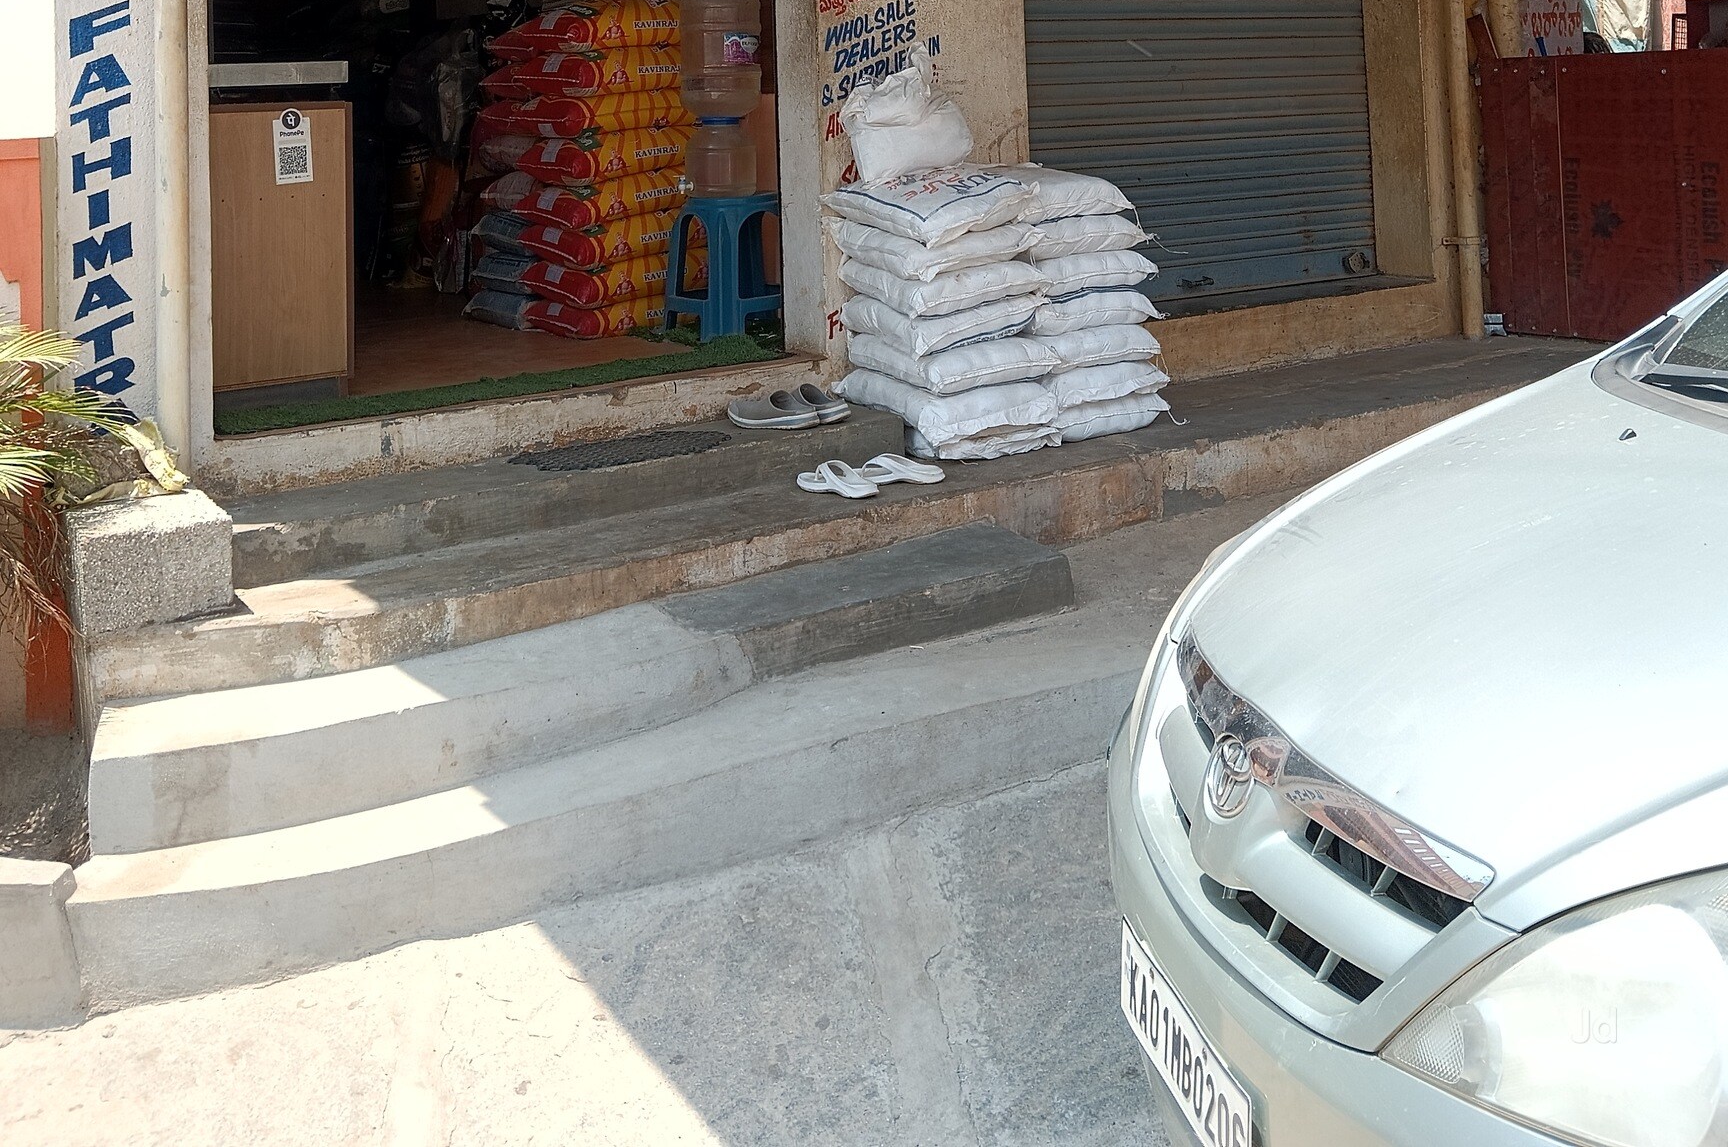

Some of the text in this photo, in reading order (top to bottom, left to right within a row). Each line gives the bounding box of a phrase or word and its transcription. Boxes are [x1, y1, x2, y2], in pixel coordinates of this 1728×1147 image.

[634, 21, 678, 29] KAVINRAJ
[834, 20, 916, 73] DEALERS
[639, 65, 680, 73] KAVINRAJ
[822, 84, 834, 107] &
[929, 35, 940, 57] IN
[635, 146, 679, 158] KAVINRAJ
[635, 186, 679, 200] KAVINRAJ
